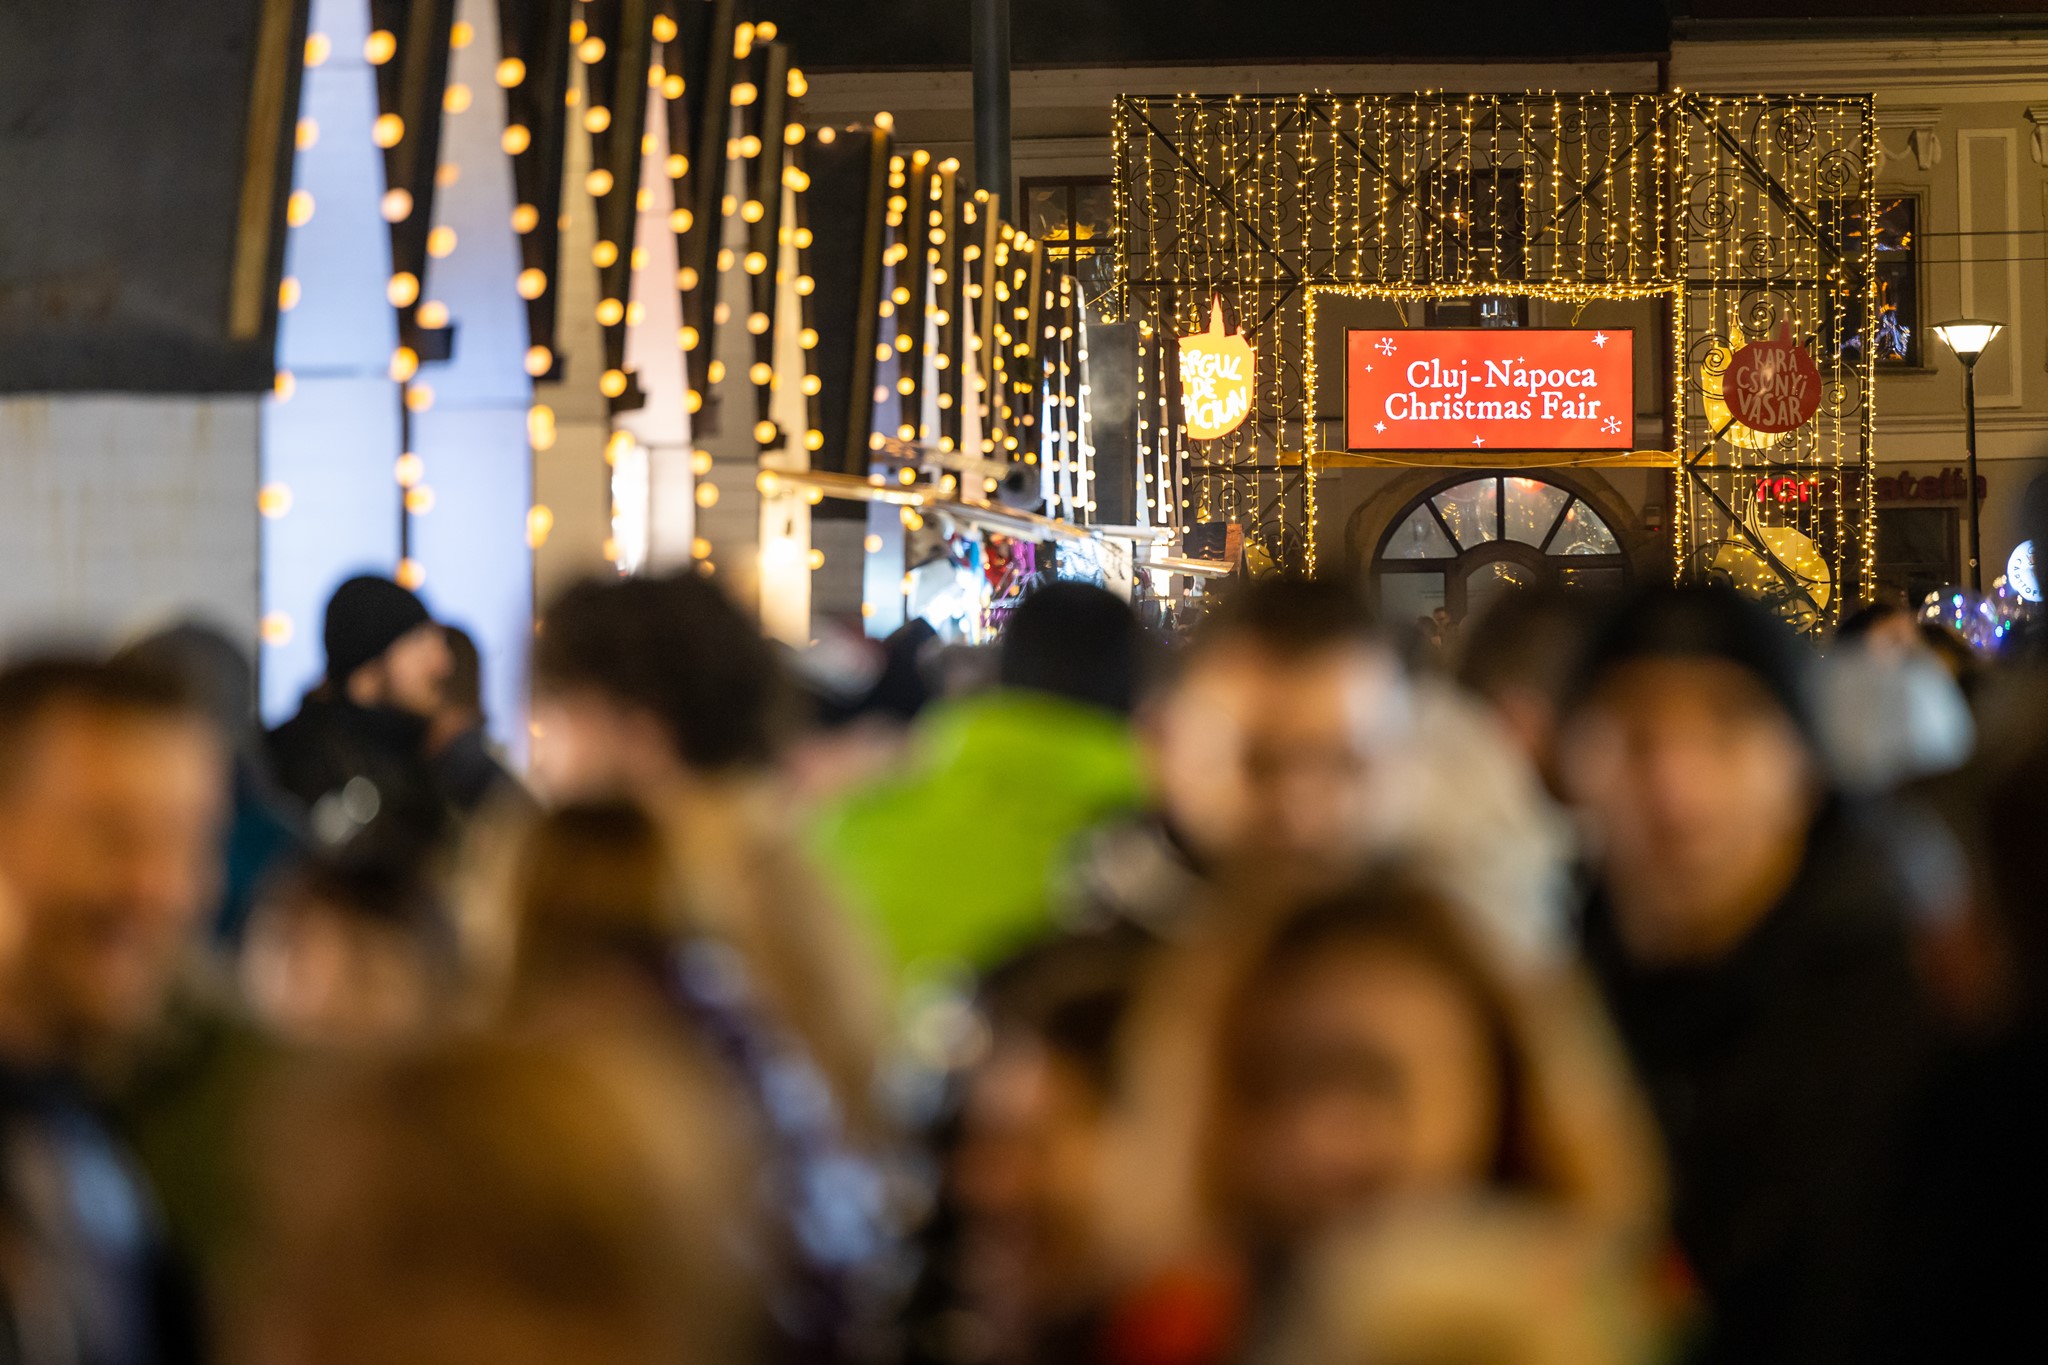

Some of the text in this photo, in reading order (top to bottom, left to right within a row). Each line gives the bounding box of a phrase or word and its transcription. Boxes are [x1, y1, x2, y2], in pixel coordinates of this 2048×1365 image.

[1752, 348, 1798, 373] KARÁ
[1192, 376, 1218, 400] DE
[1406, 357, 1598, 399] Cluj-Napoca
[1384, 391, 1602, 421] Christmas Fair
